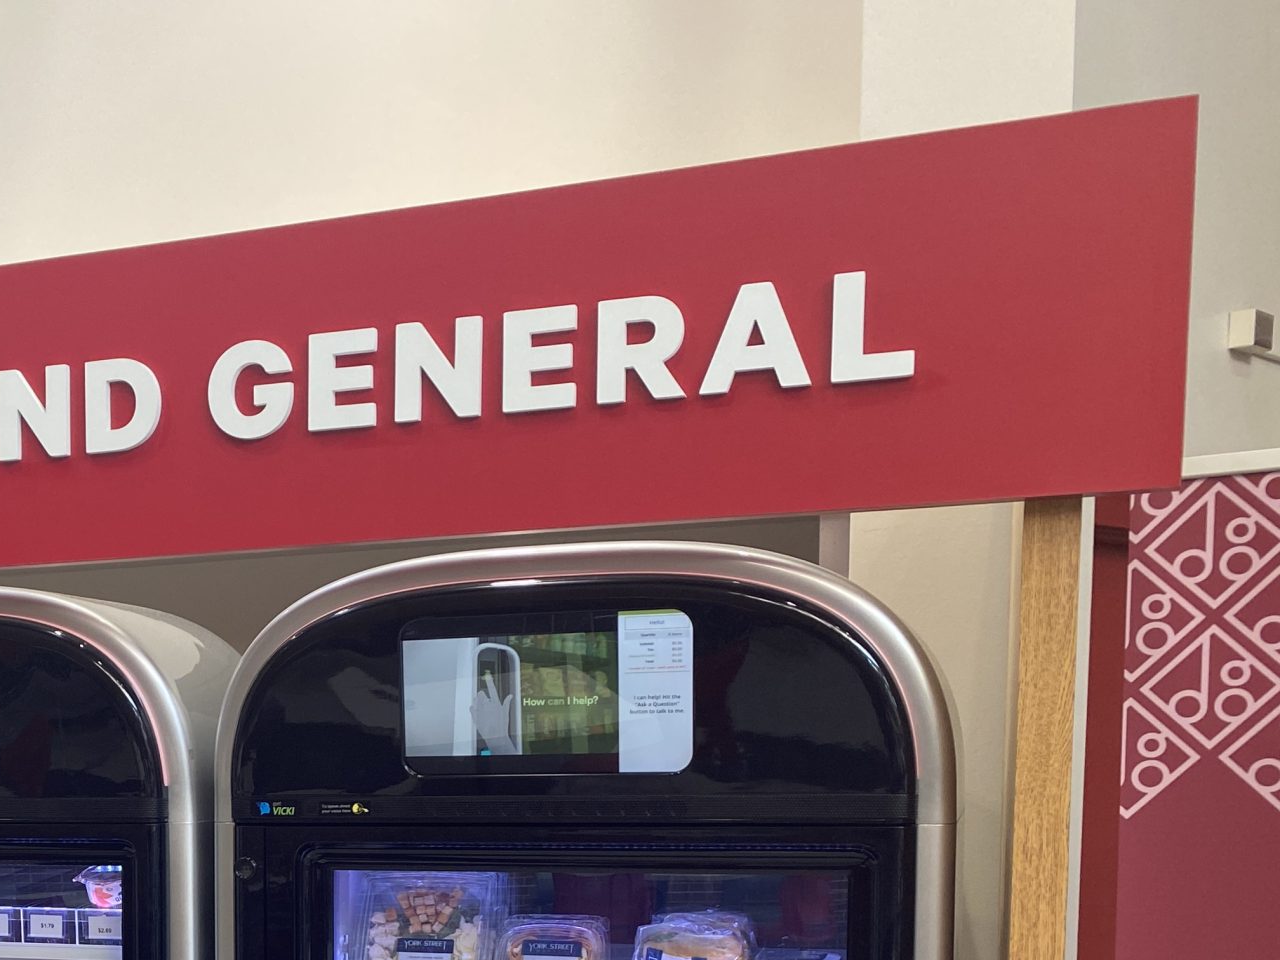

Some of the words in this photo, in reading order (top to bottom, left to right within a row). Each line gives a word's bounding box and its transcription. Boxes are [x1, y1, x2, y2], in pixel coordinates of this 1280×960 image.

[207, 270, 916, 440] GENERAL
[523, 697, 545, 707] How
[547, 697, 565, 706] can
[567, 697, 571, 705] I
[573, 695, 599, 707] help?
[272, 806, 295, 816] VICKI
[404, 940, 422, 950] YORK
[423, 940, 447, 951] STREET
[528, 943, 548, 953] YORK
[549, 943, 574, 954] STREET
